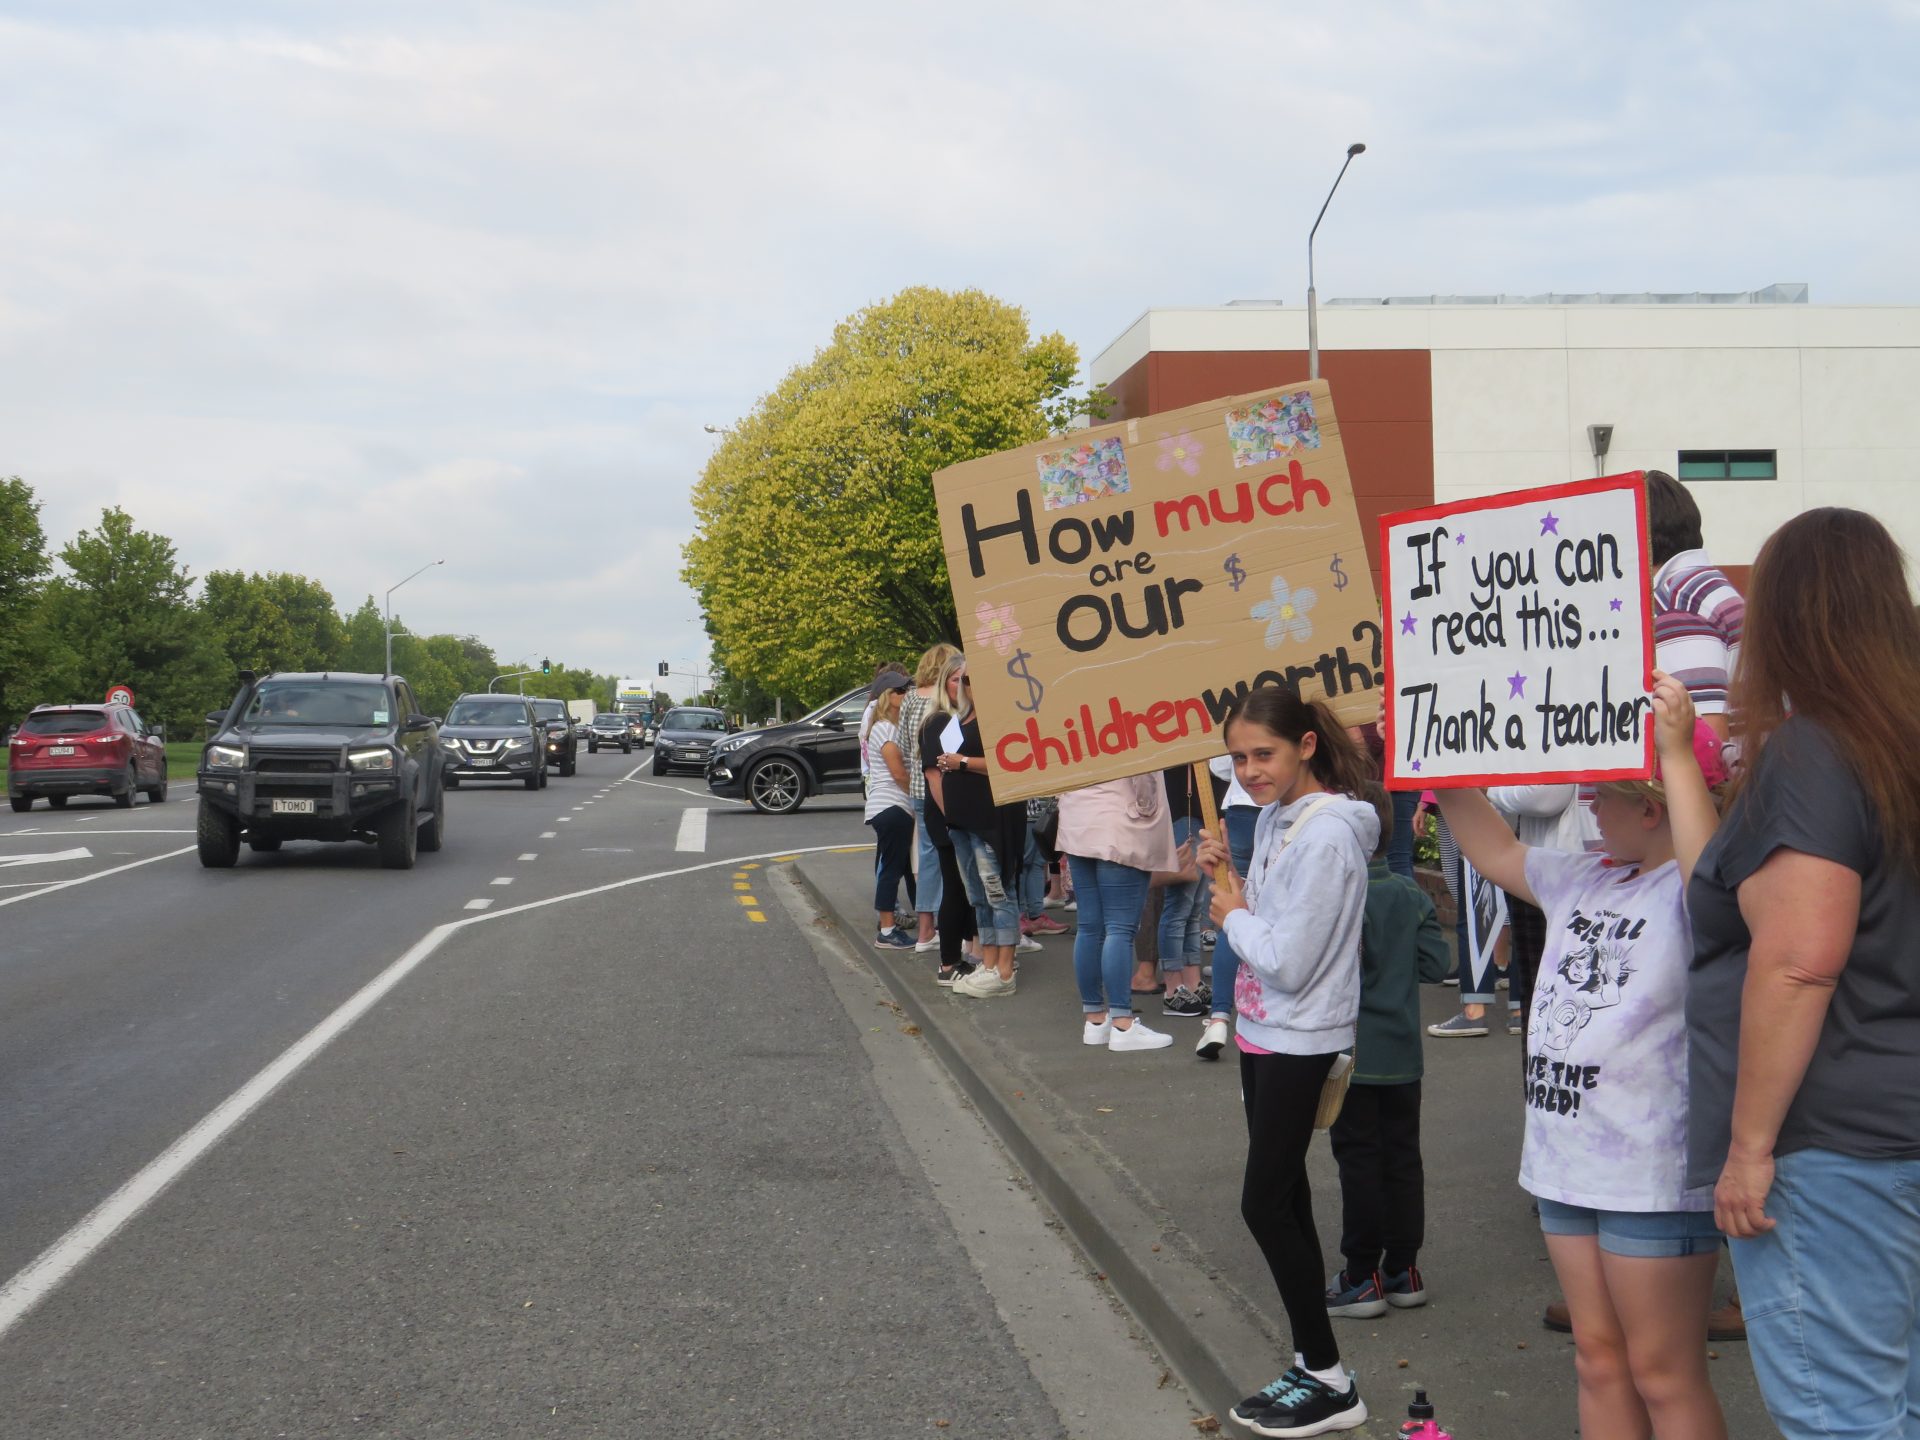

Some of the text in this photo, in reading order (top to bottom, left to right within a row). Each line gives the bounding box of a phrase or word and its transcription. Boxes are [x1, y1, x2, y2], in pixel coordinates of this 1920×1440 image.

[960, 460, 1331, 578] How much
[1089, 551, 1157, 587] are
[1406, 526, 1624, 611] If you can
[1432, 595, 1507, 656] read
[113, 694, 129, 703] 50
[1400, 665, 1651, 762] Thank a teacher
[995, 697, 1213, 772] children
[1551, 1062, 1600, 1090] THE
